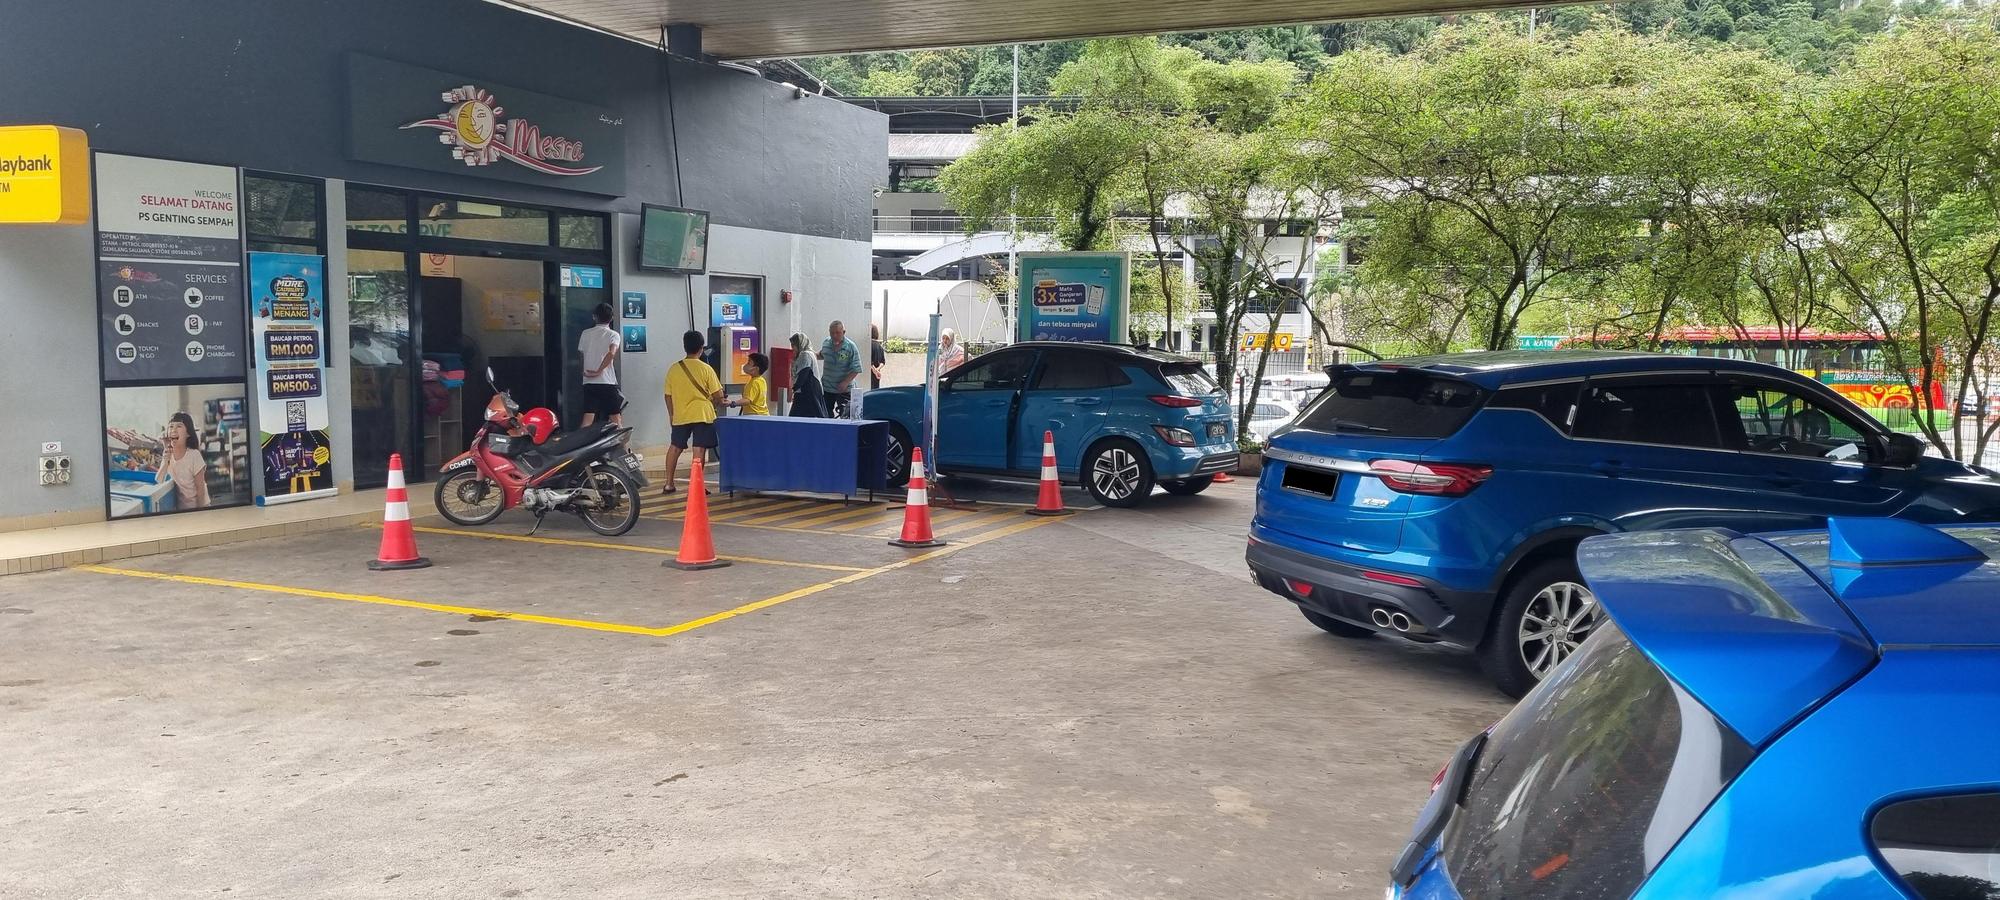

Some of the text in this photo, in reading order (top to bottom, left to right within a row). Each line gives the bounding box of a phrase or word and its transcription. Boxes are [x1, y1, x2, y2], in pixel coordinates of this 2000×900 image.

[508, 119, 584, 161] Mesra
[0, 154, 52, 176] aybank
[194, 189, 233, 200] WELCOME
[140, 195, 233, 211] SELAMAT DATANG
[138, 212, 234, 227] PS GENTING SEMPAH
[185, 273, 227, 284] SERVICES
[276, 280, 305, 288] MORE
[1037, 288, 1058, 304] 3x
[274, 310, 309, 318] MENANG!
[1071, 321, 1097, 329] minyak!
[271, 343, 314, 356] RM1,000
[272, 380, 310, 393] RM500
[1288, 453, 1337, 465] ROTON
